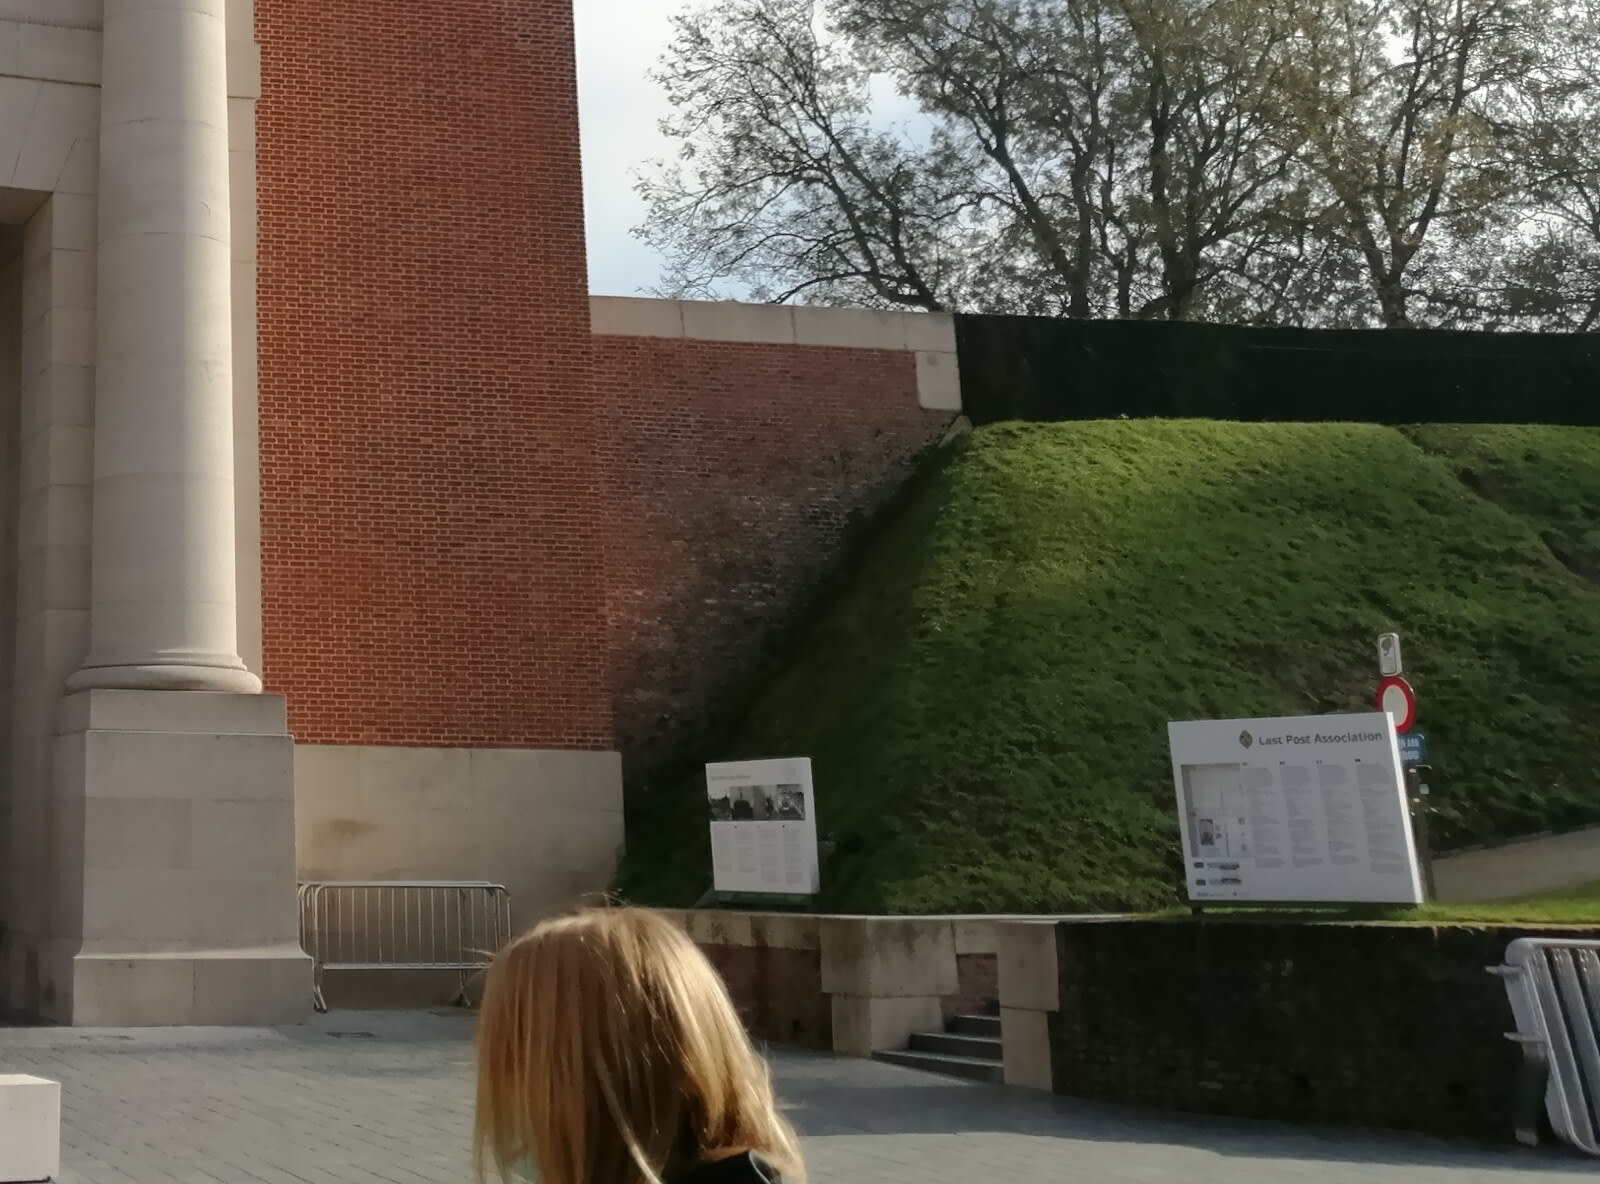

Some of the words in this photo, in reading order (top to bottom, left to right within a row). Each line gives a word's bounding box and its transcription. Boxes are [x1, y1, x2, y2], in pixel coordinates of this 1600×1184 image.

[1258, 734, 1283, 746] Last
[1285, 733, 1312, 745] Post
[1313, 730, 1383, 744] Association
